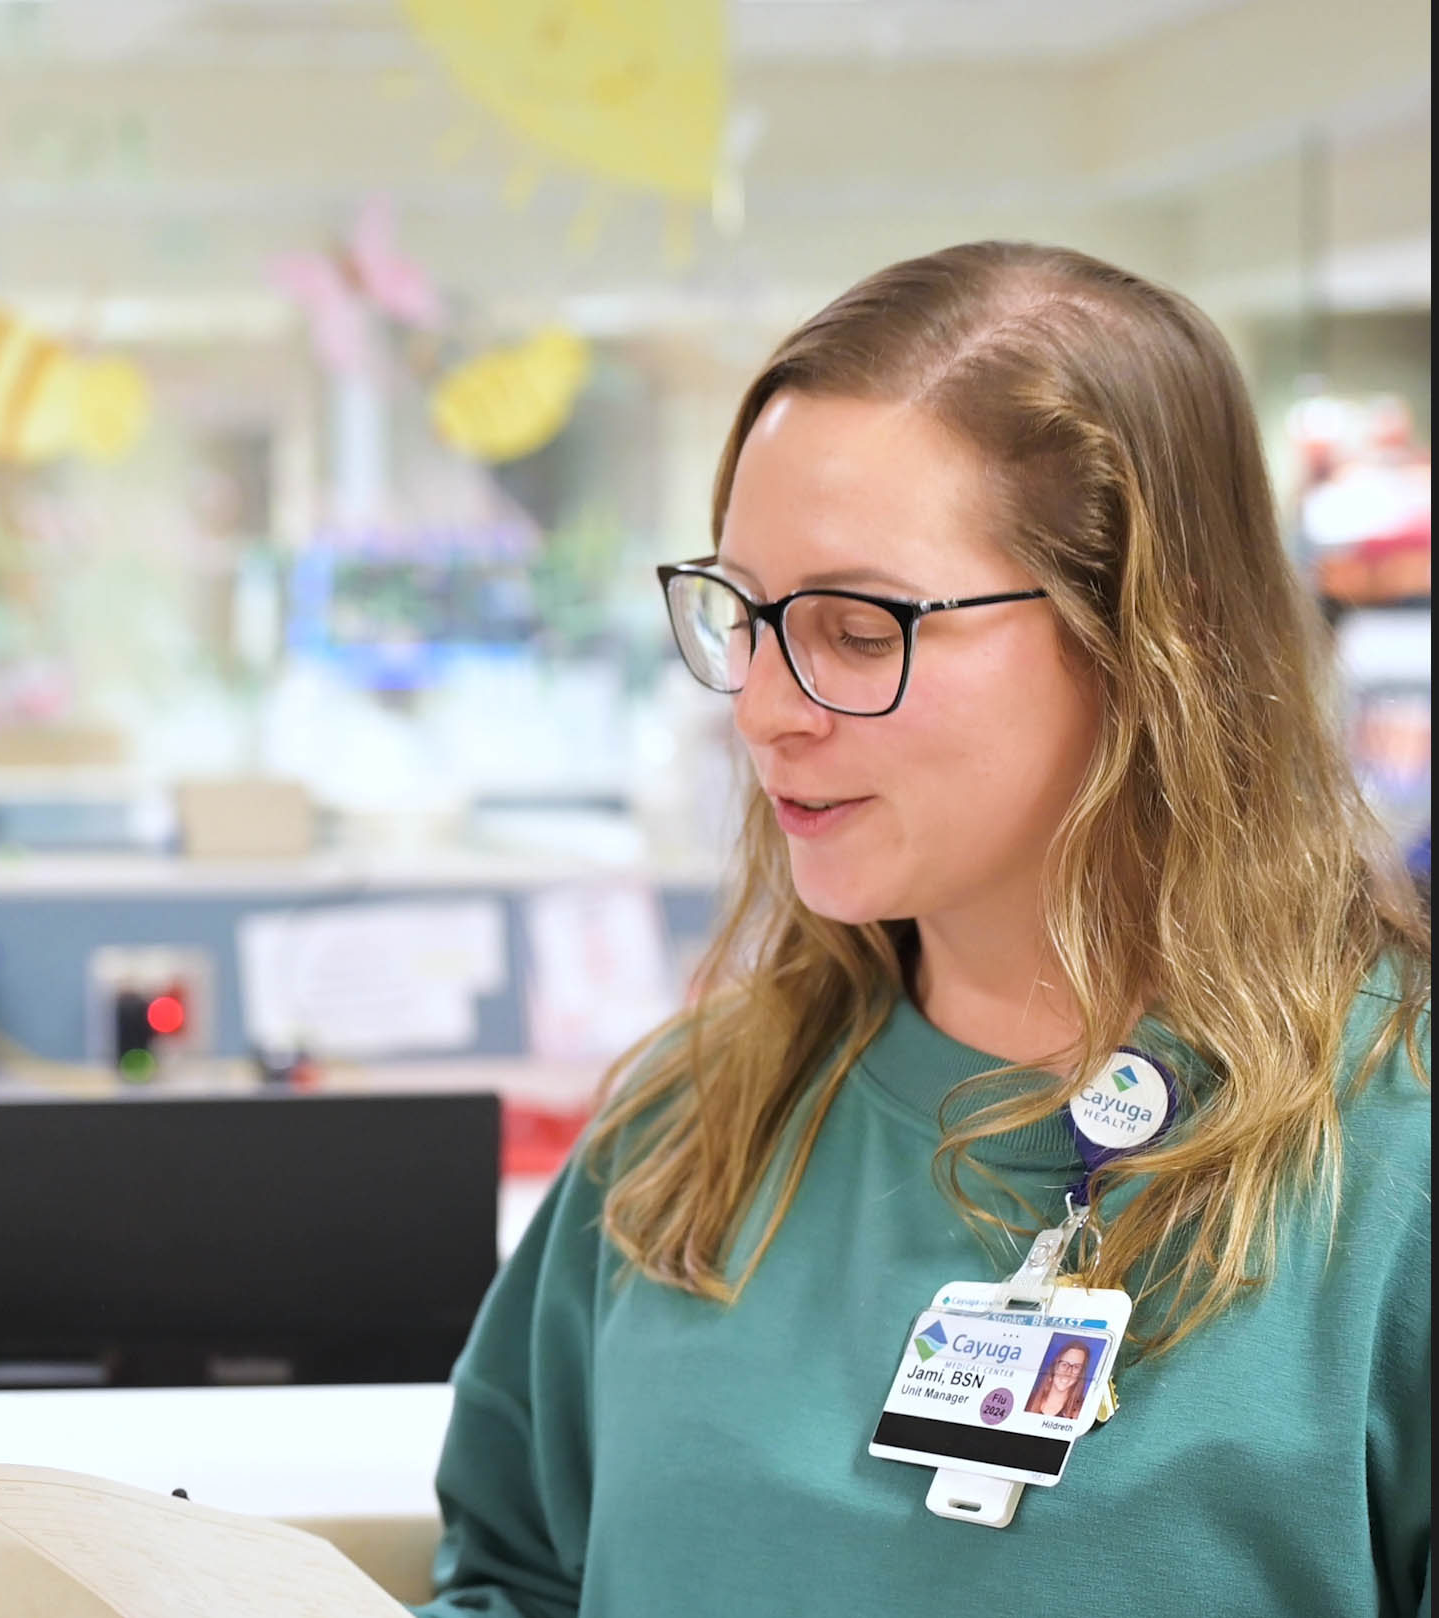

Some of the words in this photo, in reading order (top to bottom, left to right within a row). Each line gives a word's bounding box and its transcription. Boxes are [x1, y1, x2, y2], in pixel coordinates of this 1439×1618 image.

[1080, 1084, 1153, 1123] Cayuga
[1083, 1109, 1138, 1134] HEALTH
[952, 1334, 1022, 1364] Cayuga
[907, 1365, 946, 1386] Jami,
[950, 1370, 986, 1390] BSN
[944, 1360, 980, 1374] MEDICAL
[983, 1365, 1015, 1378] CENTER
[901, 1384, 923, 1398] Unit
[924, 1387, 970, 1406] Manager
[991, 1393, 1008, 1405] Flu
[983, 1405, 1006, 1418] 2024
[1041, 1420, 1074, 1433] Hildreth
